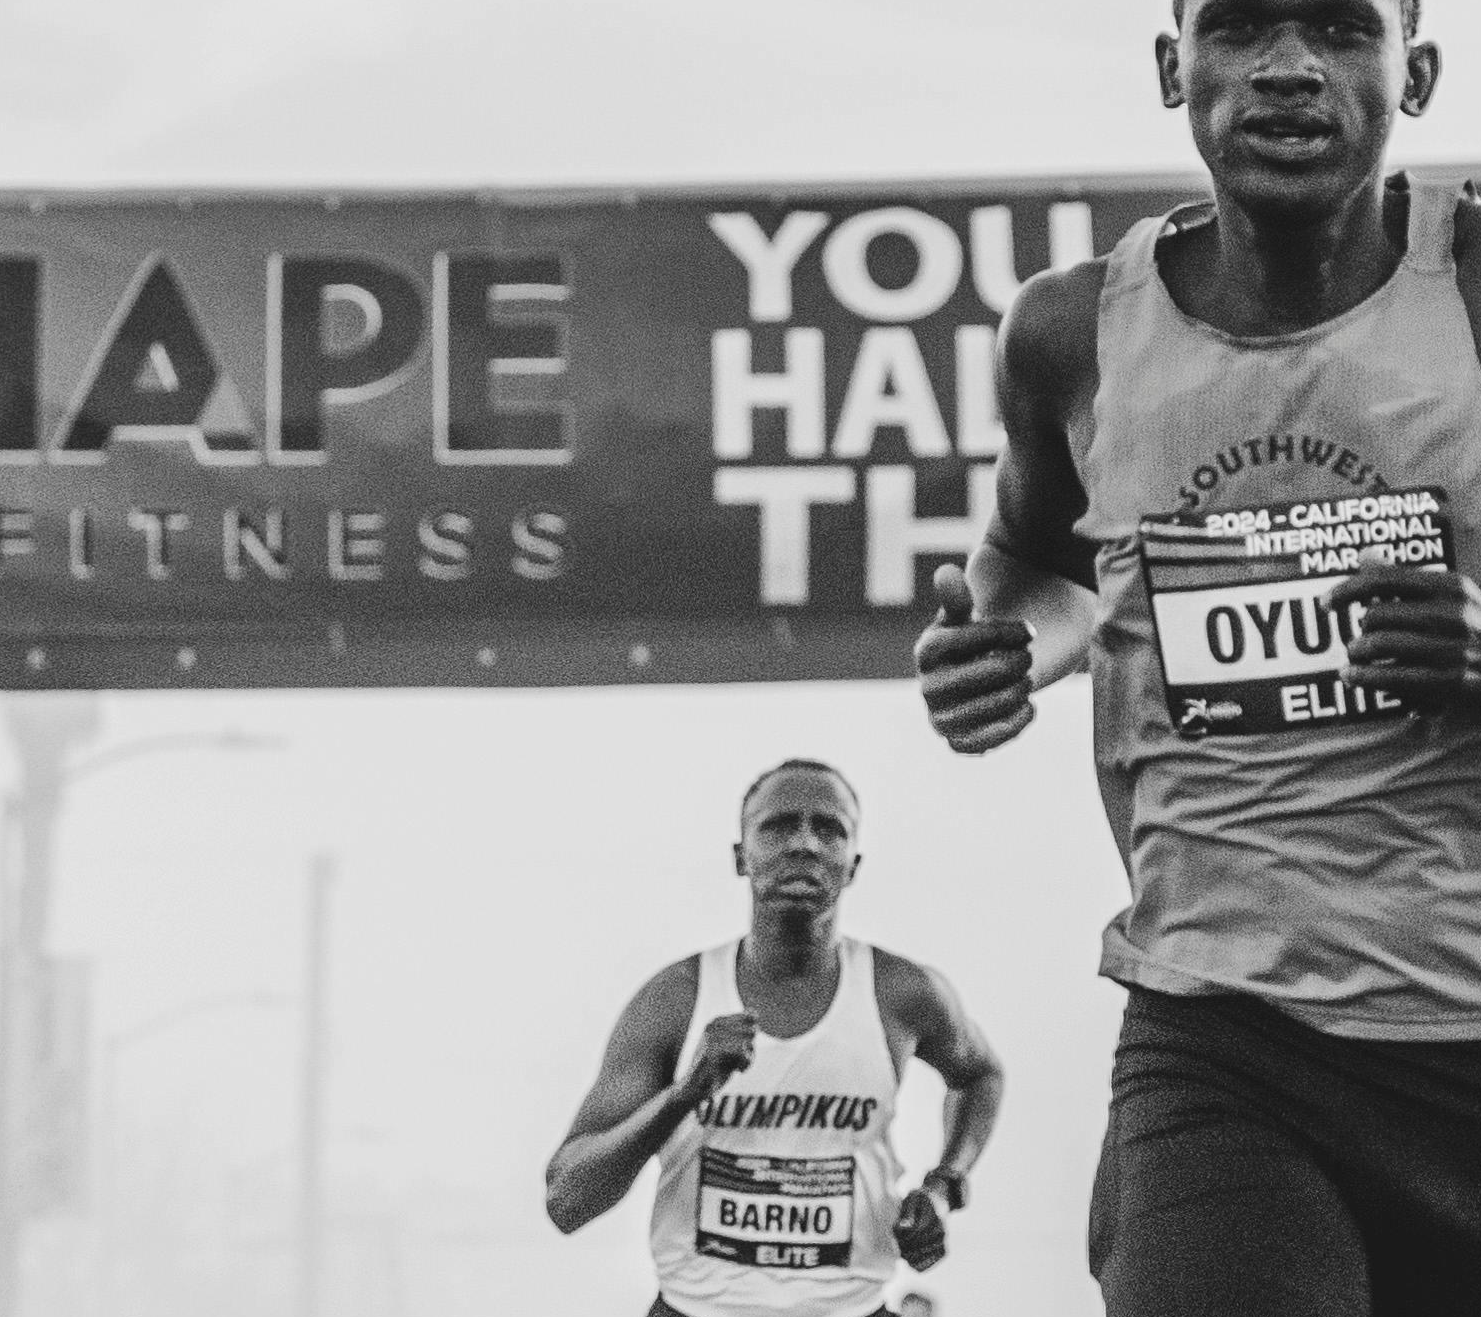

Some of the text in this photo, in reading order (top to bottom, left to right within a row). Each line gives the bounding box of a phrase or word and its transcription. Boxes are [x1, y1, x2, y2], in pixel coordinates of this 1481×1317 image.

[1205, 510, 1271, 537] 2024
[1289, 492, 1439, 529] CALIFORNIA
[1246, 515, 1441, 556] INTERNATIONAL
[719, 1198, 833, 1234] BARNO
[756, 1245, 821, 1266] ELITE
